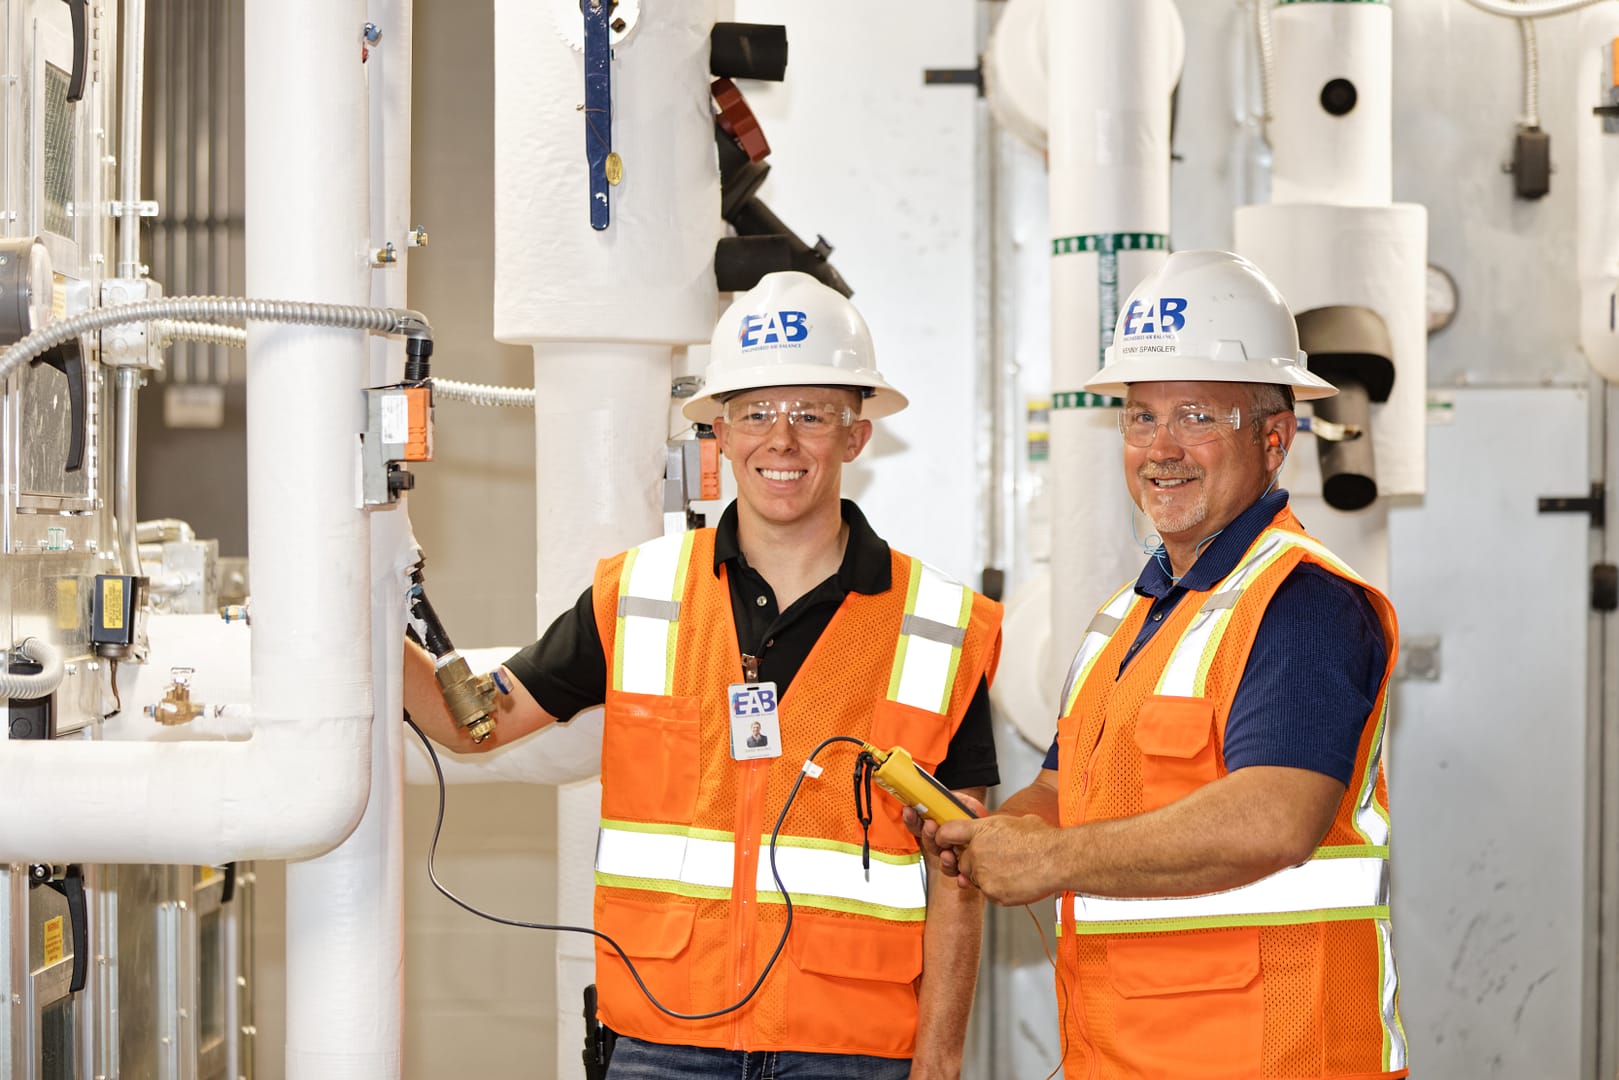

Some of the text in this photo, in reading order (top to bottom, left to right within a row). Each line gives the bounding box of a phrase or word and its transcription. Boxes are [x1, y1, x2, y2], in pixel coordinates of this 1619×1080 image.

[739, 311, 808, 348] EAB
[1124, 297, 1187, 336] EAB
[1139, 345, 1176, 353] SPANGLER
[732, 690, 776, 715] EAB
